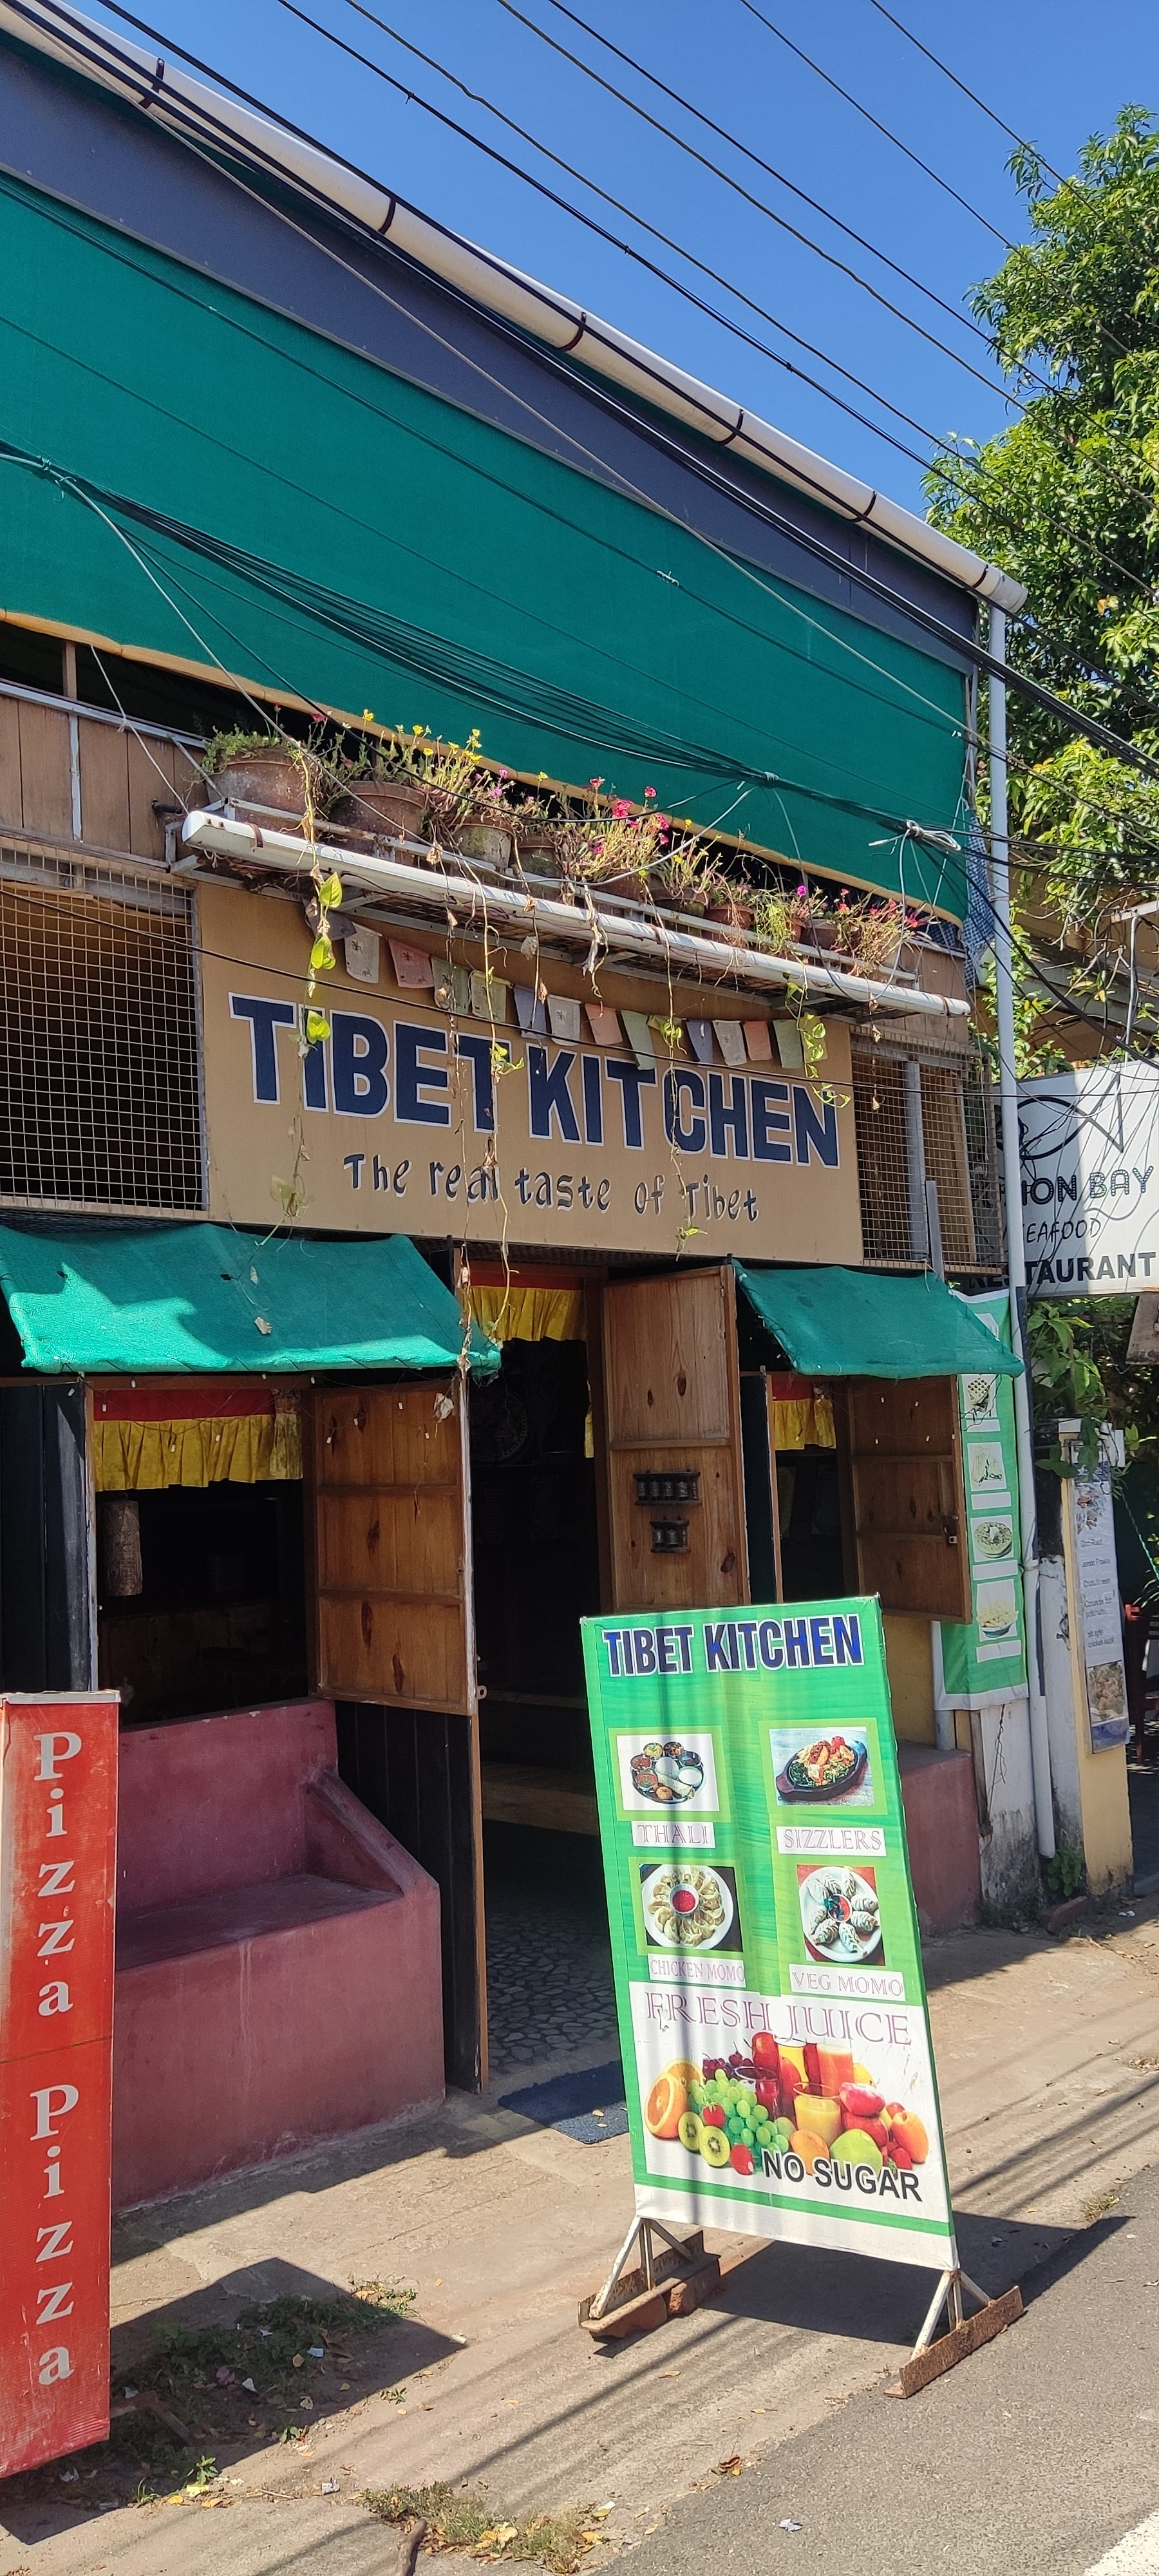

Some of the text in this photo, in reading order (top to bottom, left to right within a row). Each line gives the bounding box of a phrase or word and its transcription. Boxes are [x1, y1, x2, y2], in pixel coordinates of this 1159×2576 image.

[229, 992, 840, 1170] TIBET KITCHEN
[344, 1153, 411, 1197] The
[430, 1159, 499, 1203] real
[515, 1166, 611, 1213] taste
[634, 1173, 664, 1215] of
[1089, 1166, 1154, 1198] BAY
[1023, 1218, 1101, 1243] EAFOOD
[603, 1613, 865, 1678] TIBET KITCHEN
[636, 1824, 710, 1845] THALI
[783, 1828, 881, 1851] SIZZLERS
[649, 1958, 745, 1983] CHICKEN MOMO
[792, 1971, 904, 1997] VEG MOMO
[645, 1991, 912, 2045] FRESH JUICE
[29, 1731, 82, 2385] Pizza Pizza
[762, 2148, 923, 2202] NO SUGAR
